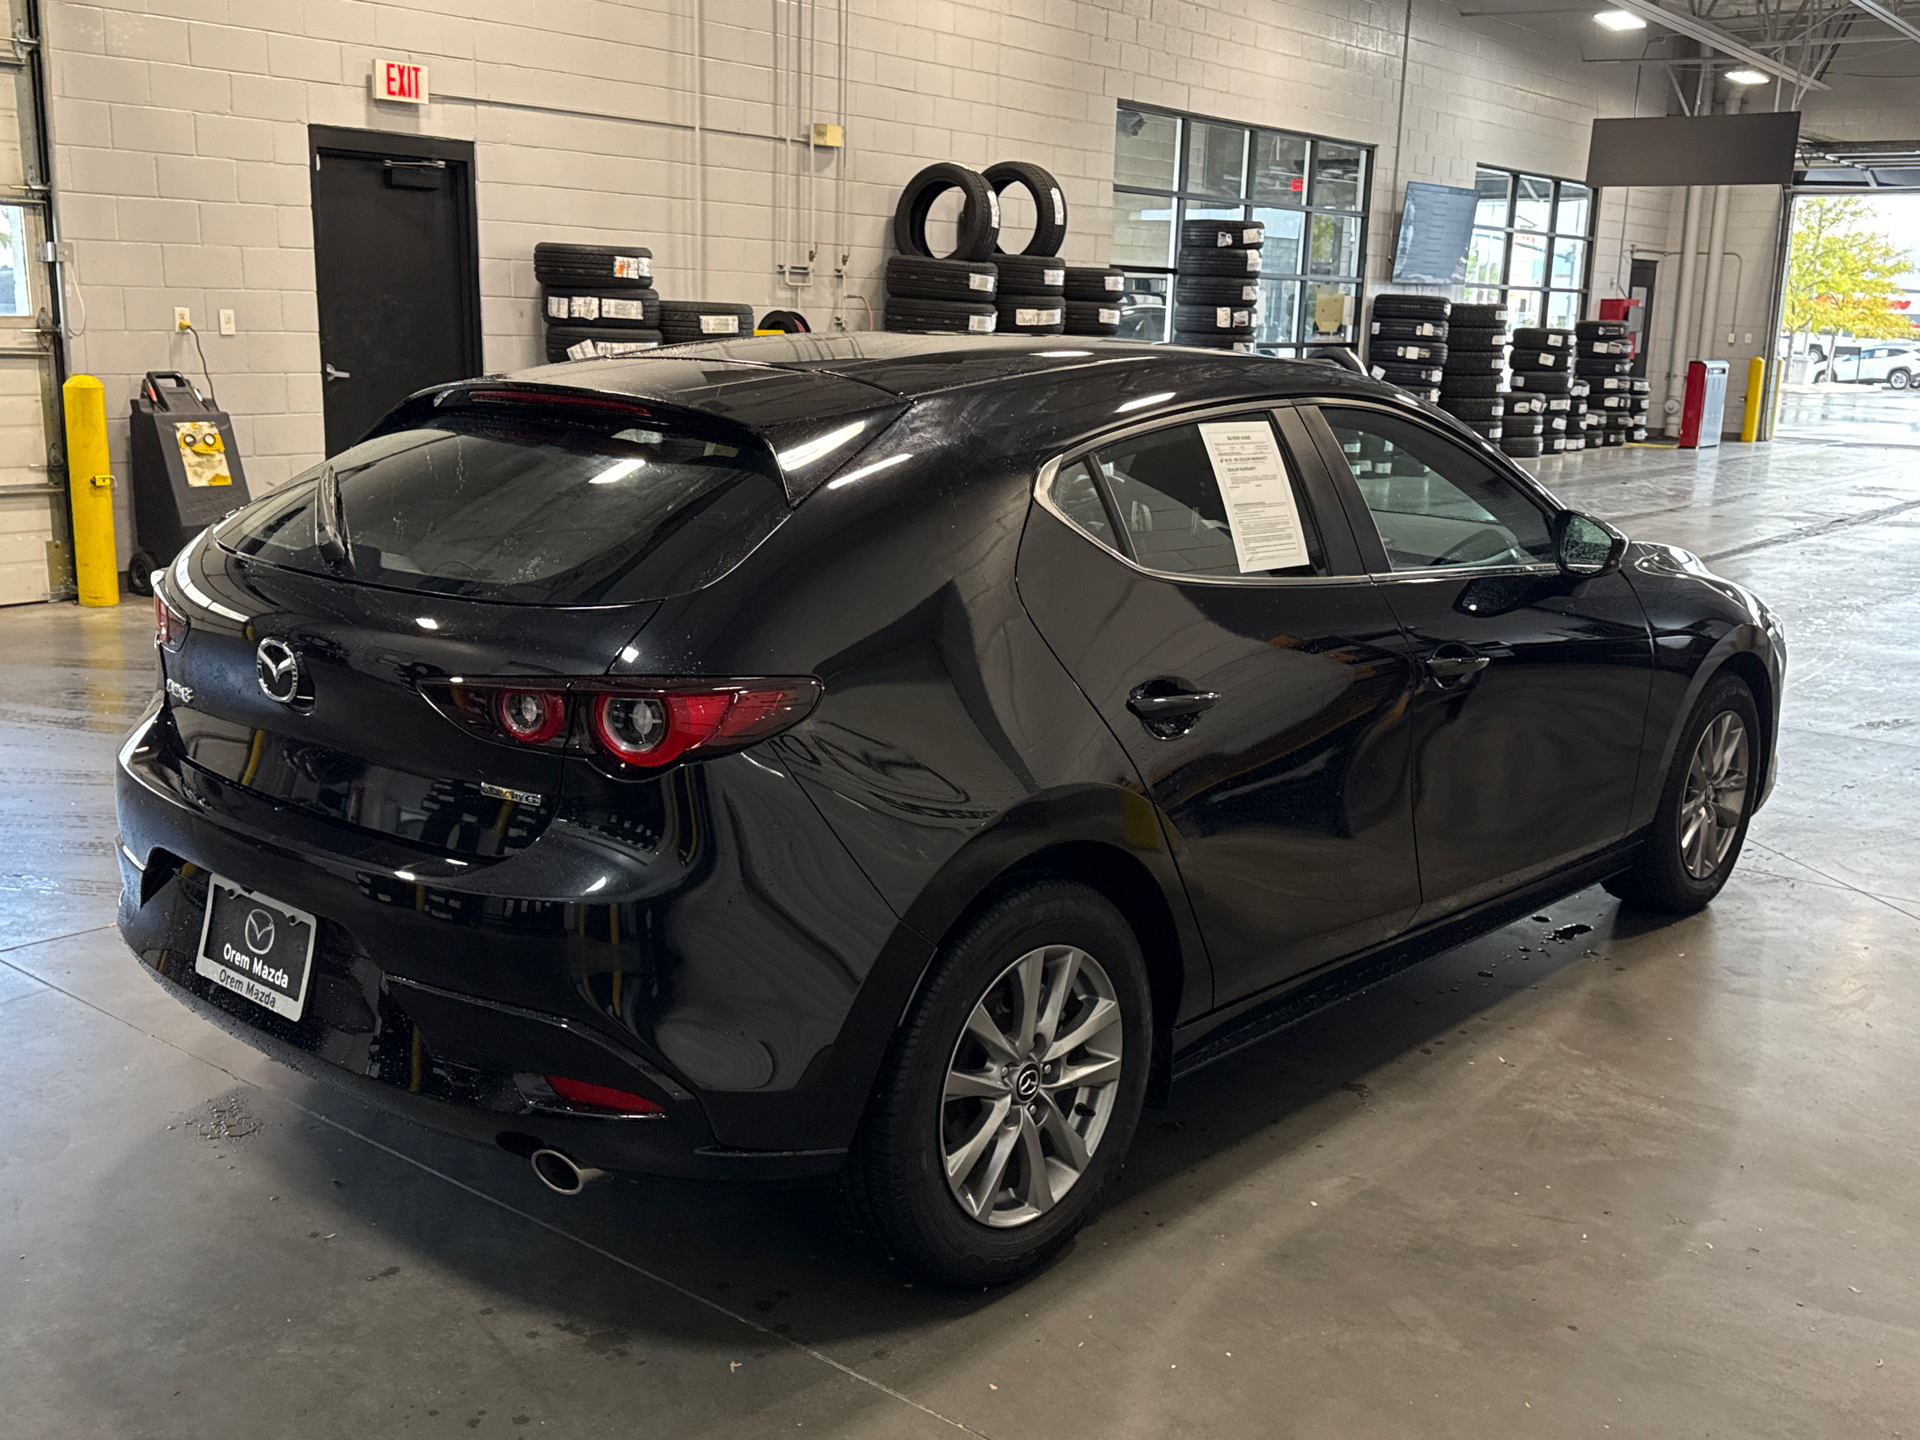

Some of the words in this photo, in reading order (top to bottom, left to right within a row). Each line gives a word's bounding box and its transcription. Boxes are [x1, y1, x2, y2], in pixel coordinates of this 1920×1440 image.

[386, 62, 421, 99] EXIT
[223, 943, 250, 970] Orem
[252, 957, 289, 988] Mazda
[219, 969, 244, 992] Orem
[245, 981, 276, 1008] Mazda
